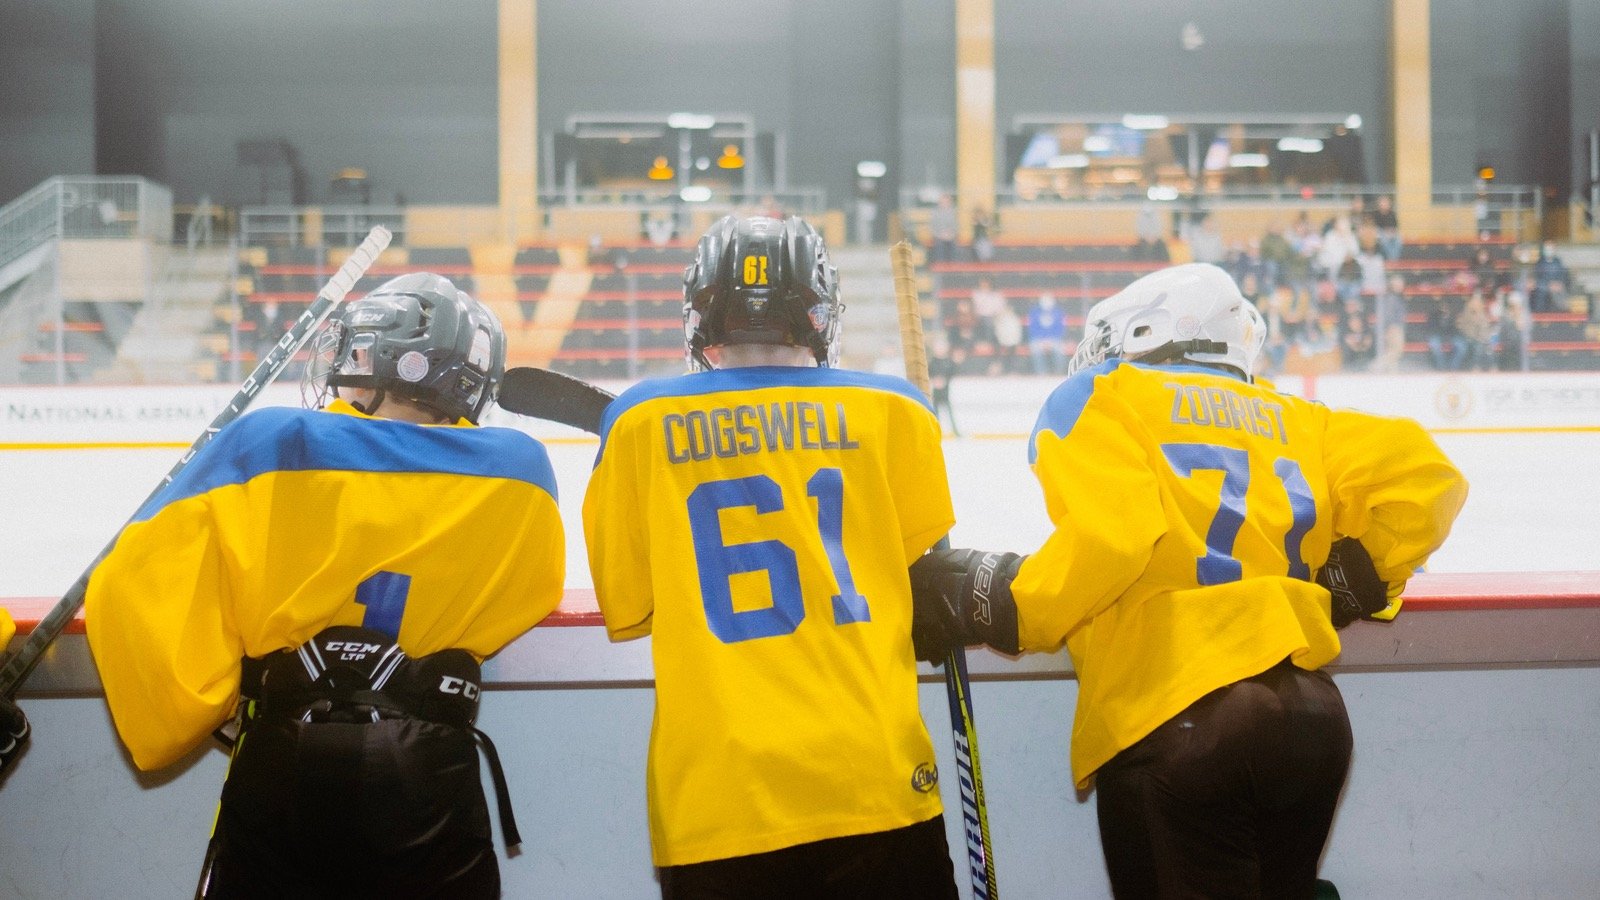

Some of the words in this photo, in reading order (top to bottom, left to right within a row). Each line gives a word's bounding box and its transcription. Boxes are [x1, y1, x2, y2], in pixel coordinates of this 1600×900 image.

[743, 255, 768, 285] 61
[662, 401, 860, 465] COGSWELL
[1164, 383, 1288, 445] ZOBRIST
[1159, 443, 1317, 586] 71
[686, 468, 871, 644] 61
[354, 570, 412, 643] 1
[325, 641, 382, 654] CCM
[340, 652, 366, 661] LTP
[439, 675, 481, 702] CC
[953, 729, 988, 900] RRIOR
